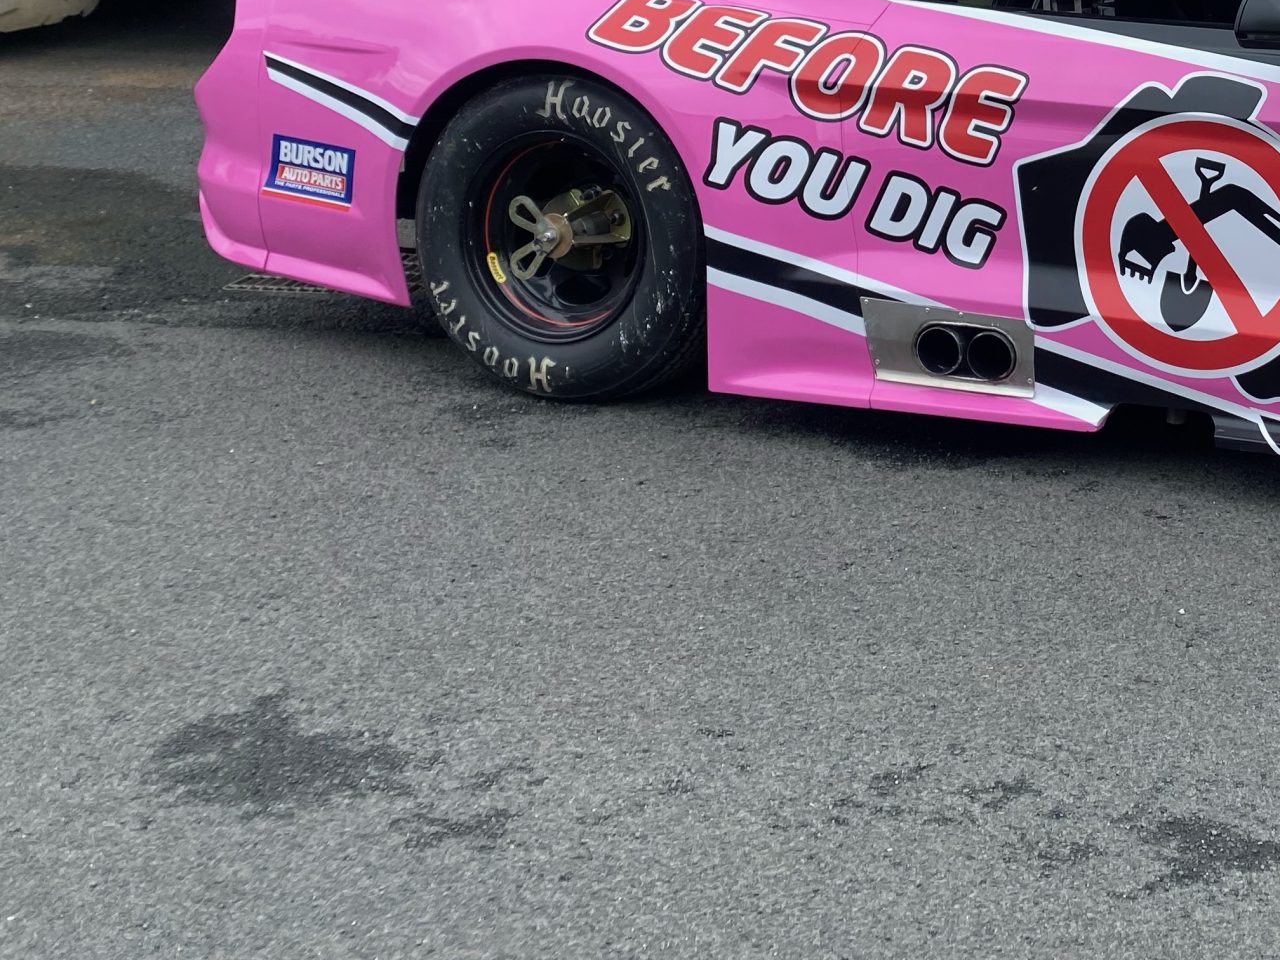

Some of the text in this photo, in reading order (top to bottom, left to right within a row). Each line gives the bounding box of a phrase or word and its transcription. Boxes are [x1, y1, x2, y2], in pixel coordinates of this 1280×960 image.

[279, 140, 348, 174] BURSON
[536, 80, 673, 192] Hoosier
[281, 167, 342, 190] AUTO PARTS
[703, 117, 1007, 269] YOU DIG
